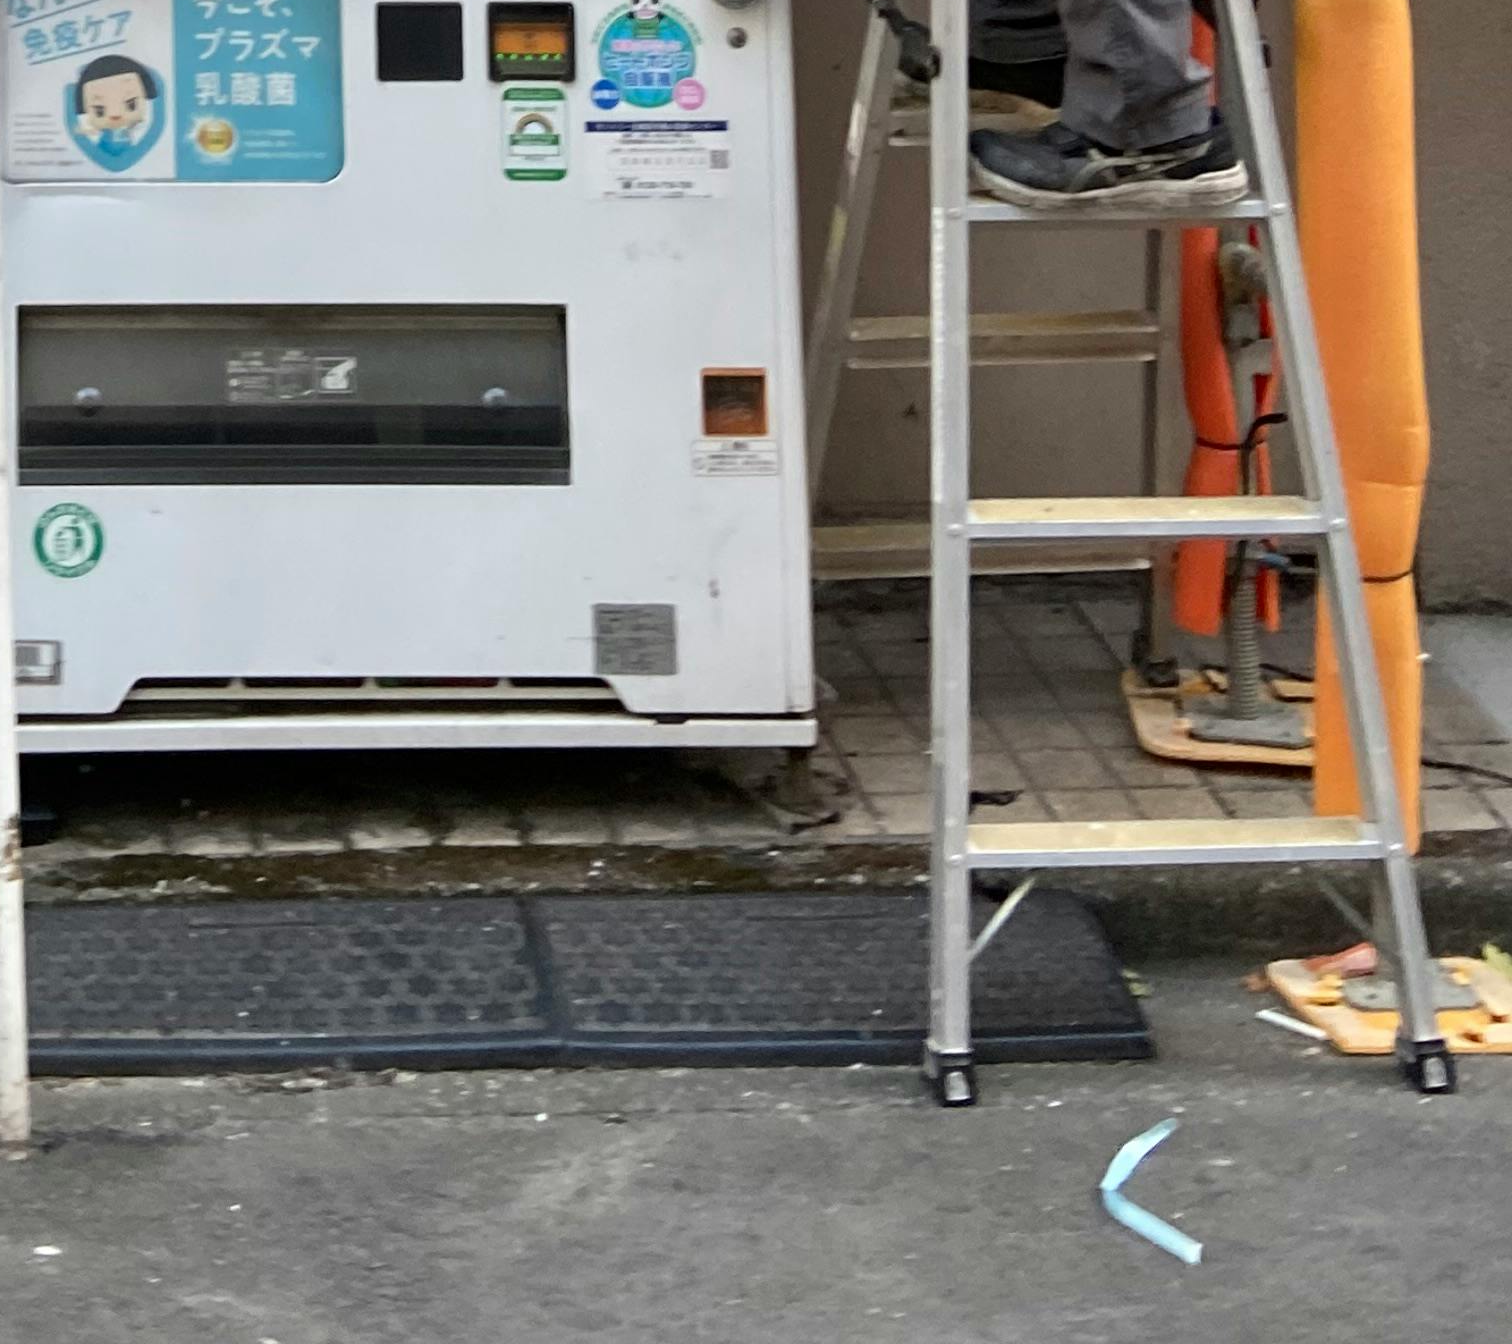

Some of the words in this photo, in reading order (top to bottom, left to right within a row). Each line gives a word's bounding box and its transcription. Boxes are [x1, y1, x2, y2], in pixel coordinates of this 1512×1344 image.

[22, 10, 134, 58] 免疫ケア
[194, 26, 322, 62] プラズマ
[194, 71, 298, 107] 乳酸菌
